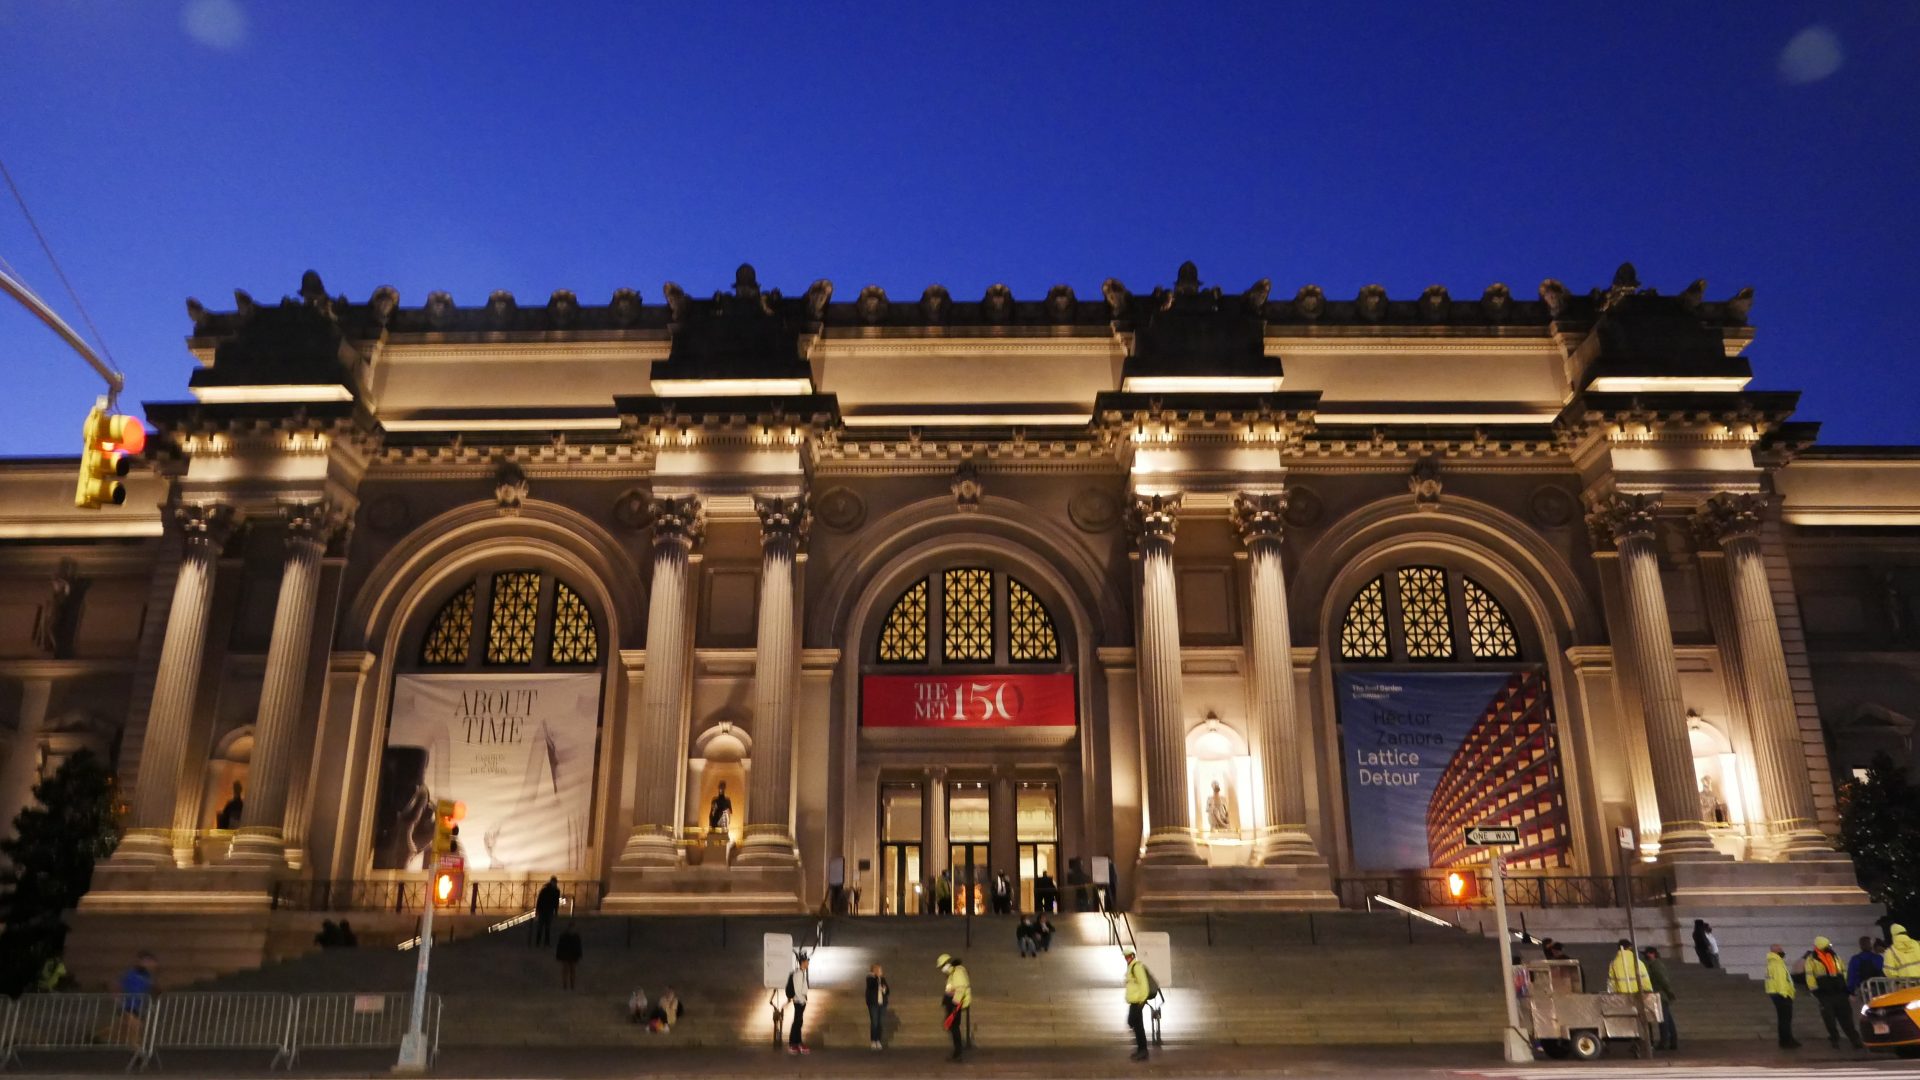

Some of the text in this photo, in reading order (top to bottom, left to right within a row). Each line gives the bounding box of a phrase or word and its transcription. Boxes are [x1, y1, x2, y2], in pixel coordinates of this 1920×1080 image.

[454, 689, 538, 716] ABOUT
[953, 682, 1024, 720] 150
[914, 701, 949, 720] MET
[463, 717, 524, 744] TIME
[1376, 730, 1444, 746] Zamora
[1357, 748, 1420, 766] Lattice
[1359, 768, 1420, 786] Detour
[1472, 831, 1512, 840] ONE WAY
